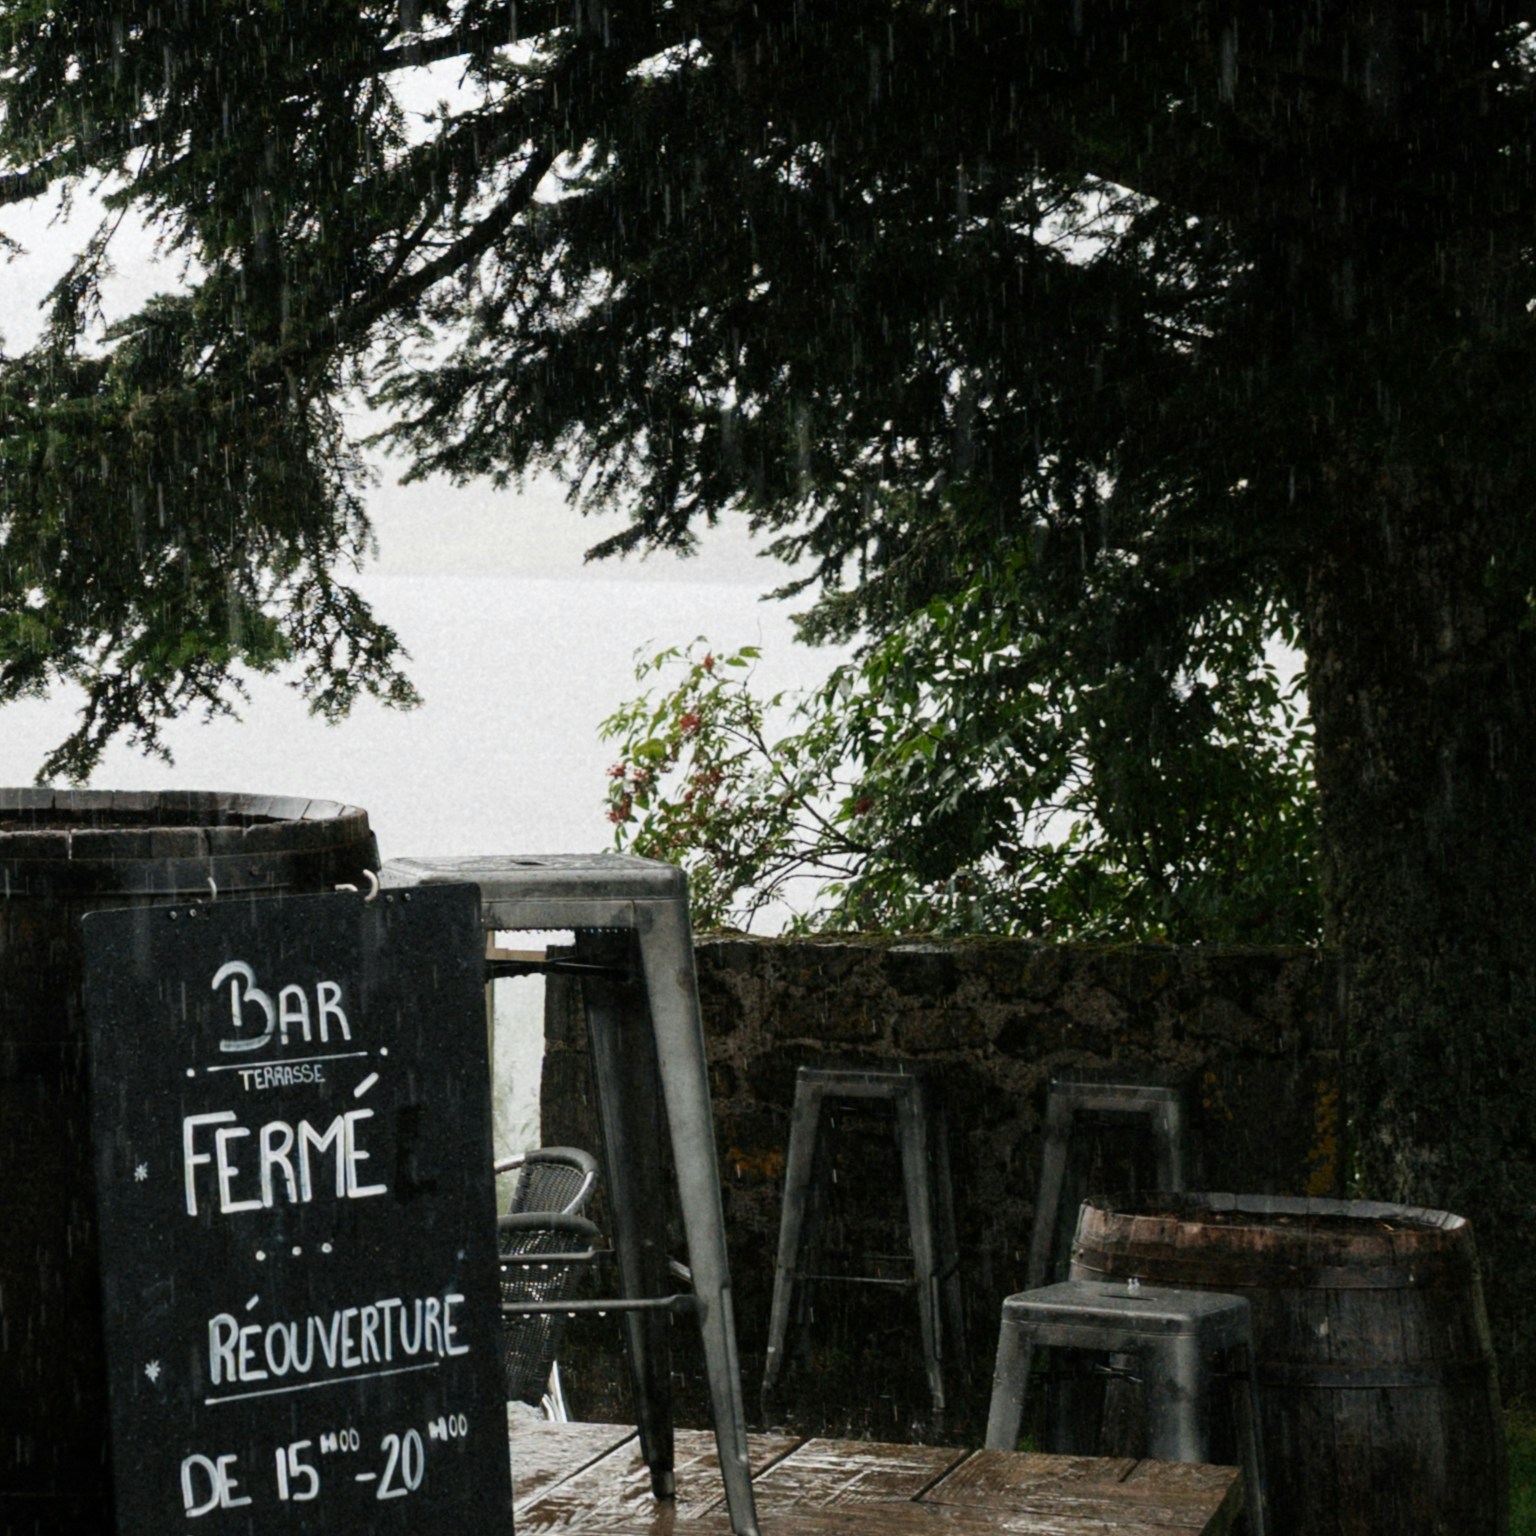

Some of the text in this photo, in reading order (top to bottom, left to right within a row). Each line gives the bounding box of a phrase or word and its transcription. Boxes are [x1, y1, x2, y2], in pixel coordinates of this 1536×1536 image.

[211, 960, 352, 1053] BAR
[238, 1064, 325, 1091] TERRASSE
[182, 1071, 388, 1217] FERMÉ
[208, 1294, 470, 1385] RÉOUVERTURE
[180, 1453, 253, 1518] DE
